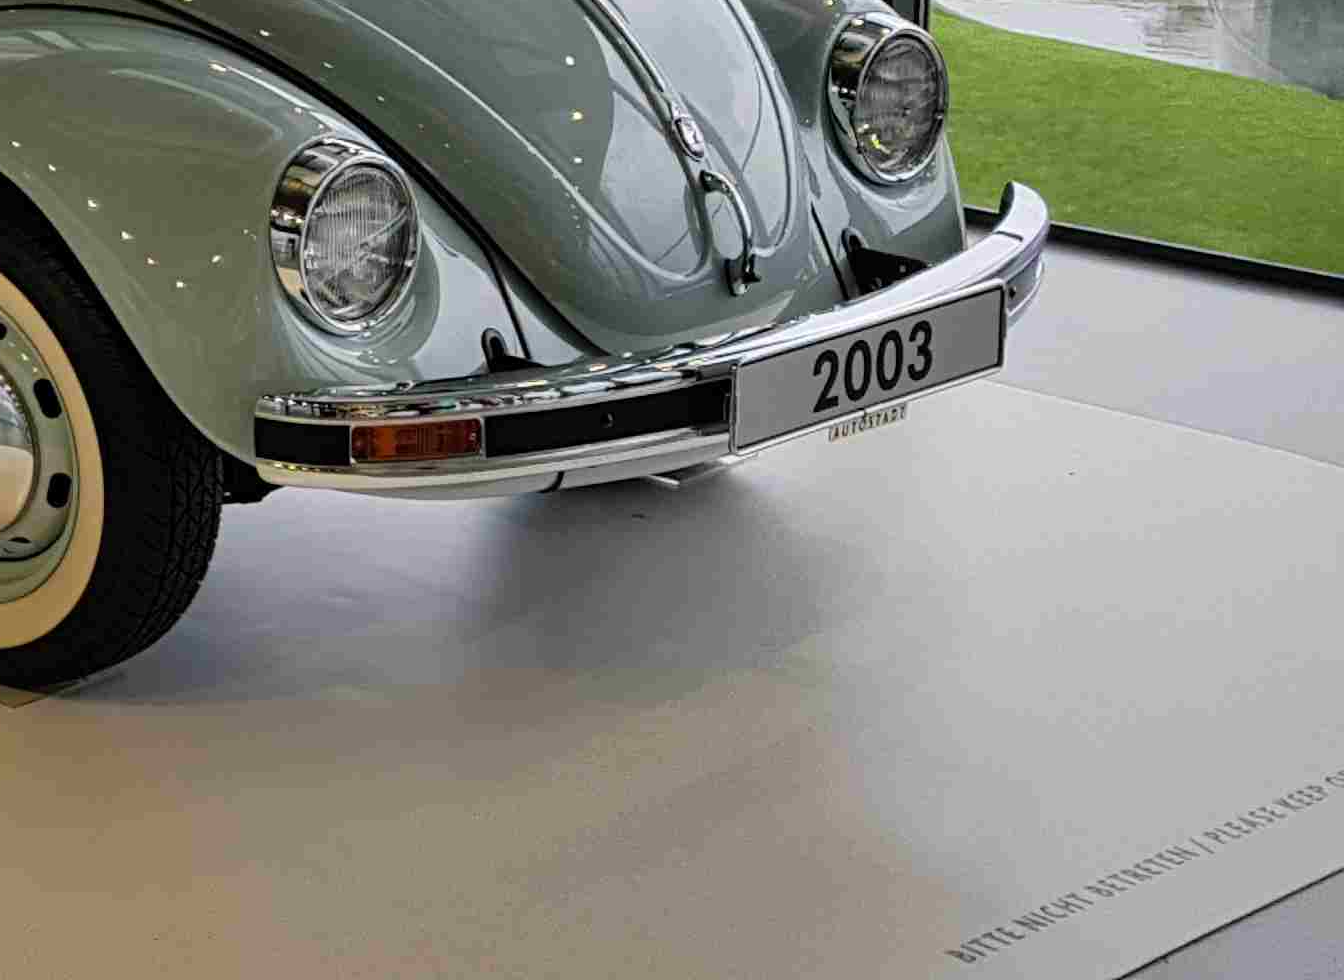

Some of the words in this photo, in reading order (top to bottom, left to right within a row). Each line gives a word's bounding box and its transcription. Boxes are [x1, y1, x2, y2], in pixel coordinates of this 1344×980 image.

[813, 320, 933, 413] 2003
[831, 406, 907, 440] AUTOSTADT
[943, 925, 1026, 965] BITTE
[1012, 892, 1094, 933] NICHT
[1083, 844, 1201, 899] BETRETEN
[1202, 805, 1287, 846] PLEASE
[1271, 784, 1328, 813] KEEP
